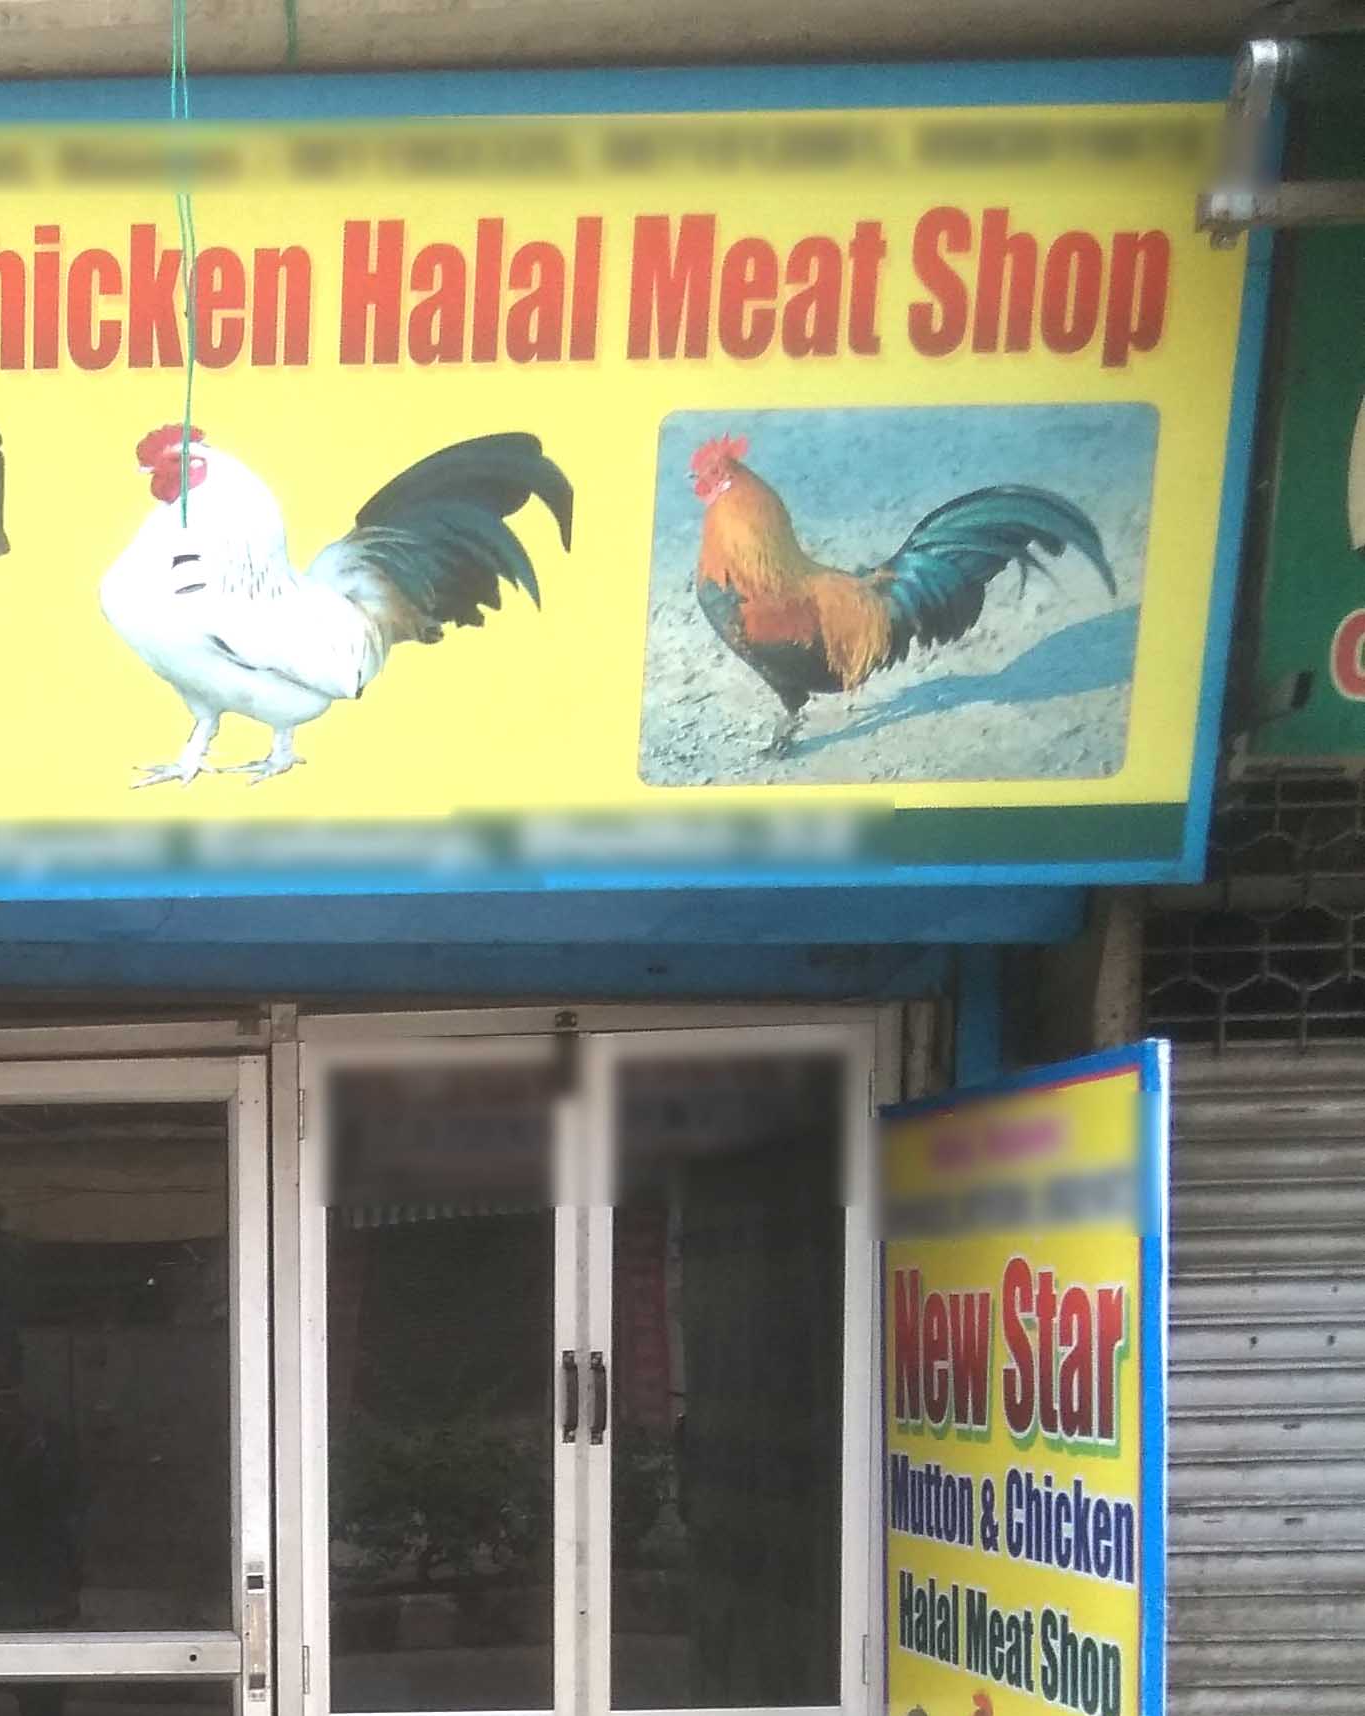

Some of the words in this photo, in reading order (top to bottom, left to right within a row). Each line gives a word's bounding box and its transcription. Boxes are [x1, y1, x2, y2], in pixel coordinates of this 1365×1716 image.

[339, 216, 603, 366] Halal
[626, 213, 888, 361] Meat
[907, 206, 1172, 368] Shop
[892, 1265, 992, 1436] New
[1000, 1256, 1126, 1446] Star
[889, 1453, 974, 1548] Mutton
[980, 1475, 999, 1554] &
[1004, 1466, 1136, 1584] Chicken
[898, 1570, 959, 1667] Halal
[965, 1586, 1035, 1694] Meat
